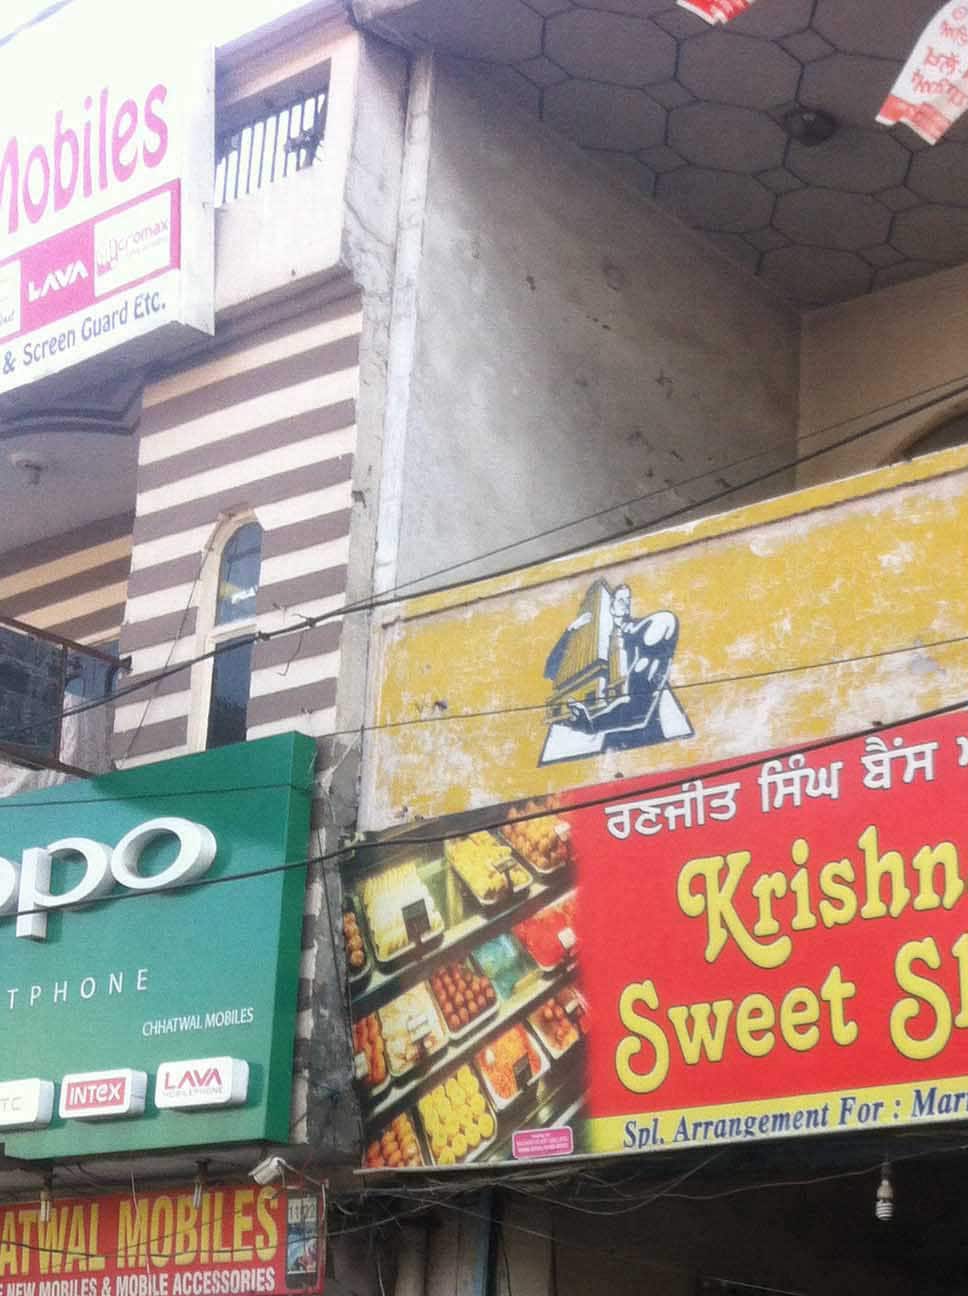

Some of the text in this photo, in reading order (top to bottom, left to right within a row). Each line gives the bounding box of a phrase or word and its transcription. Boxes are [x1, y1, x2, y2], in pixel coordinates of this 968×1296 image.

[28, 260, 88, 302] LAVA
[3, 292, 166, 375] & Screen Guard Etc.
[604, 779, 741, 840] ਰਣਜੀਤ
[758, 753, 843, 813] ਸਿੰਘ
[861, 736, 939, 789] ਬੈਂਸ
[143, 1007, 254, 1037] CHHATWAL MOBILES
[615, 965, 858, 1093] Sweet
[164, 1068, 223, 1090] LAVA
[622, 1120, 665, 1149] Spl.
[673, 1102, 829, 1144] Arrangement
[839, 1096, 885, 1126] For
[117, 1188, 279, 1270] MOBILES
[172, 1268, 276, 1296] ACCESSORIES
